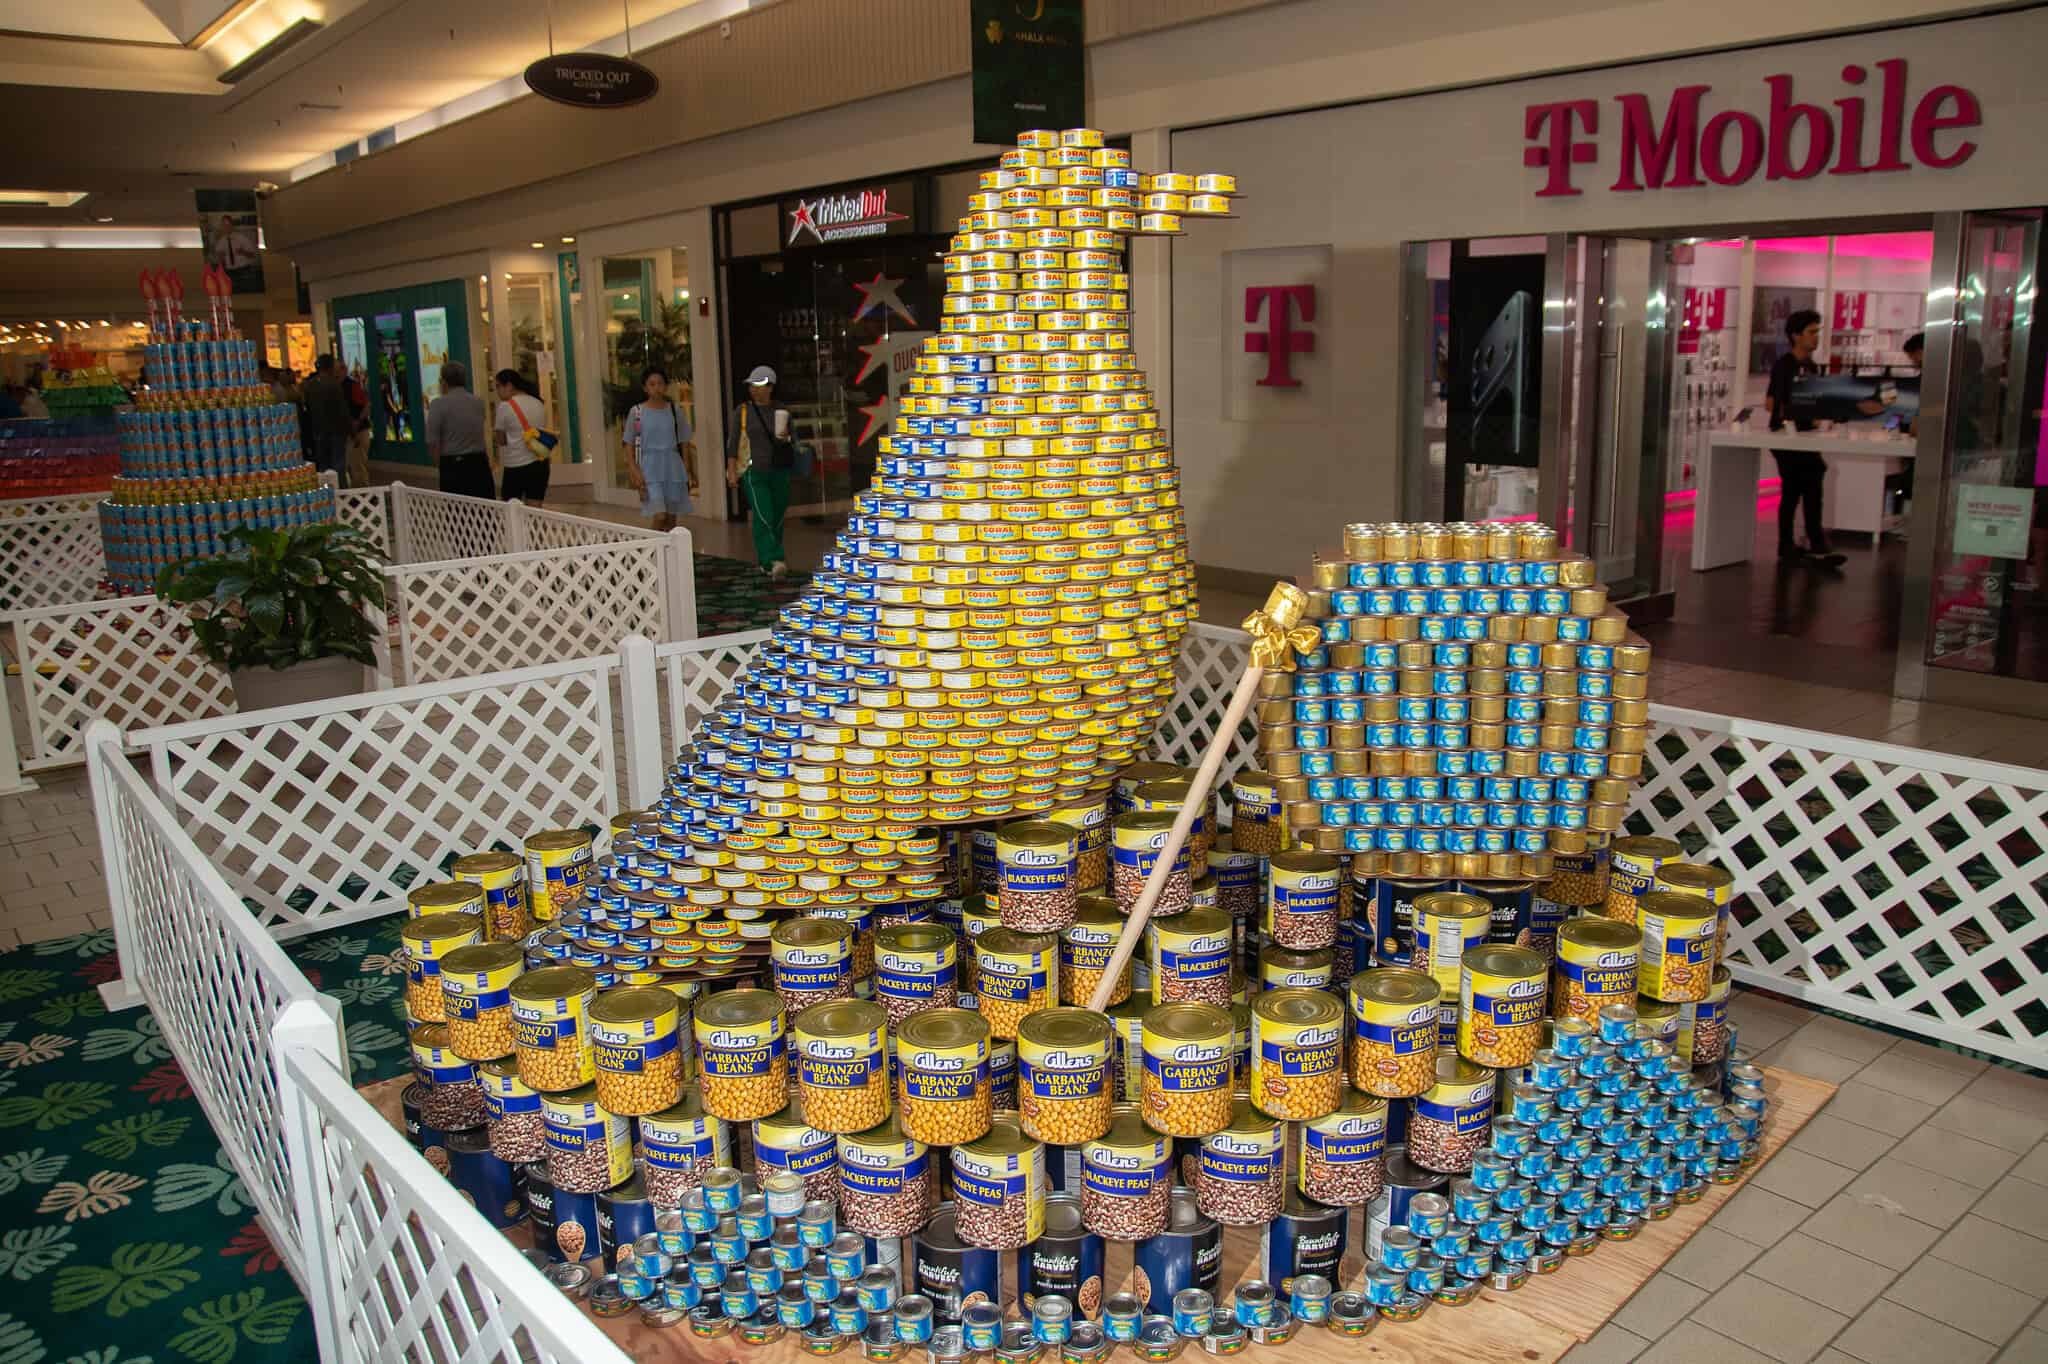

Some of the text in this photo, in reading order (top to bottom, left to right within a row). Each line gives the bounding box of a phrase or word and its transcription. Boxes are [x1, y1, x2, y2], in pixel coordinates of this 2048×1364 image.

[555, 67, 631, 83] TRICKED OUT
[1524, 57, 1983, 197] T Mobile
[1244, 284, 1315, 387] T
[1016, 850, 1056, 866] Allens
[1008, 873, 1065, 885] BLACKEYE PEAS
[1290, 894, 1324, 907] BLACKEYE
[1070, 928, 1109, 943] Allens
[786, 951, 828, 965] Allens
[883, 955, 922, 973] Allens
[982, 955, 1017, 974] Allens
[1073, 956, 1105, 966] BEANS
[1598, 952, 1636, 970] Allens
[818, 972, 837, 983] PEAS
[1286, 973, 1325, 988] Allens
[911, 981, 932, 992] PEAS
[983, 985, 1013, 998] BEANS
[1507, 981, 1545, 998] Allens
[1601, 980, 1633, 993] BEANS
[1511, 1008, 1542, 1023] BEANS
[711, 1032, 757, 1047] Allens
[1296, 1027, 1339, 1046] Allens
[1412, 1036, 1437, 1050] BEAN
[704, 1051, 767, 1064] GARBANZO
[808, 1041, 854, 1059] Allens
[1175, 1045, 1222, 1061] Allens
[915, 1053, 962, 1070] Allens
[1045, 1052, 1093, 1068] Allens
[1300, 1059, 1335, 1074] BEANS
[716, 1062, 754, 1074] BEANS
[802, 1060, 865, 1076] GARBANZO
[1165, 1063, 1228, 1077] GARBANZO
[813, 1072, 850, 1086] BEANS
[908, 1073, 973, 1087] GARBANZO
[1036, 1071, 1100, 1084] GARBANZO
[1180, 1075, 1217, 1089] BEANS
[920, 1086, 959, 1097] BEANS
[1050, 1082, 1089, 1095] BEANS
[1338, 1119, 1382, 1136] Allens
[561, 1133, 582, 1145] PEAS
[1212, 1136, 1258, 1153] Allens
[669, 1150, 692, 1163] PEAS
[1327, 1143, 1370, 1156] BLACKEYE
[791, 1150, 833, 1169] BLACKEYE
[1093, 1149, 1138, 1168] Allens
[1203, 1159, 1269, 1174] BLACKEYE PEAS
[876, 1176, 900, 1188] PEAS
[1126, 1178, 1149, 1189] PEAS
[978, 1184, 1002, 1199] PEAS
